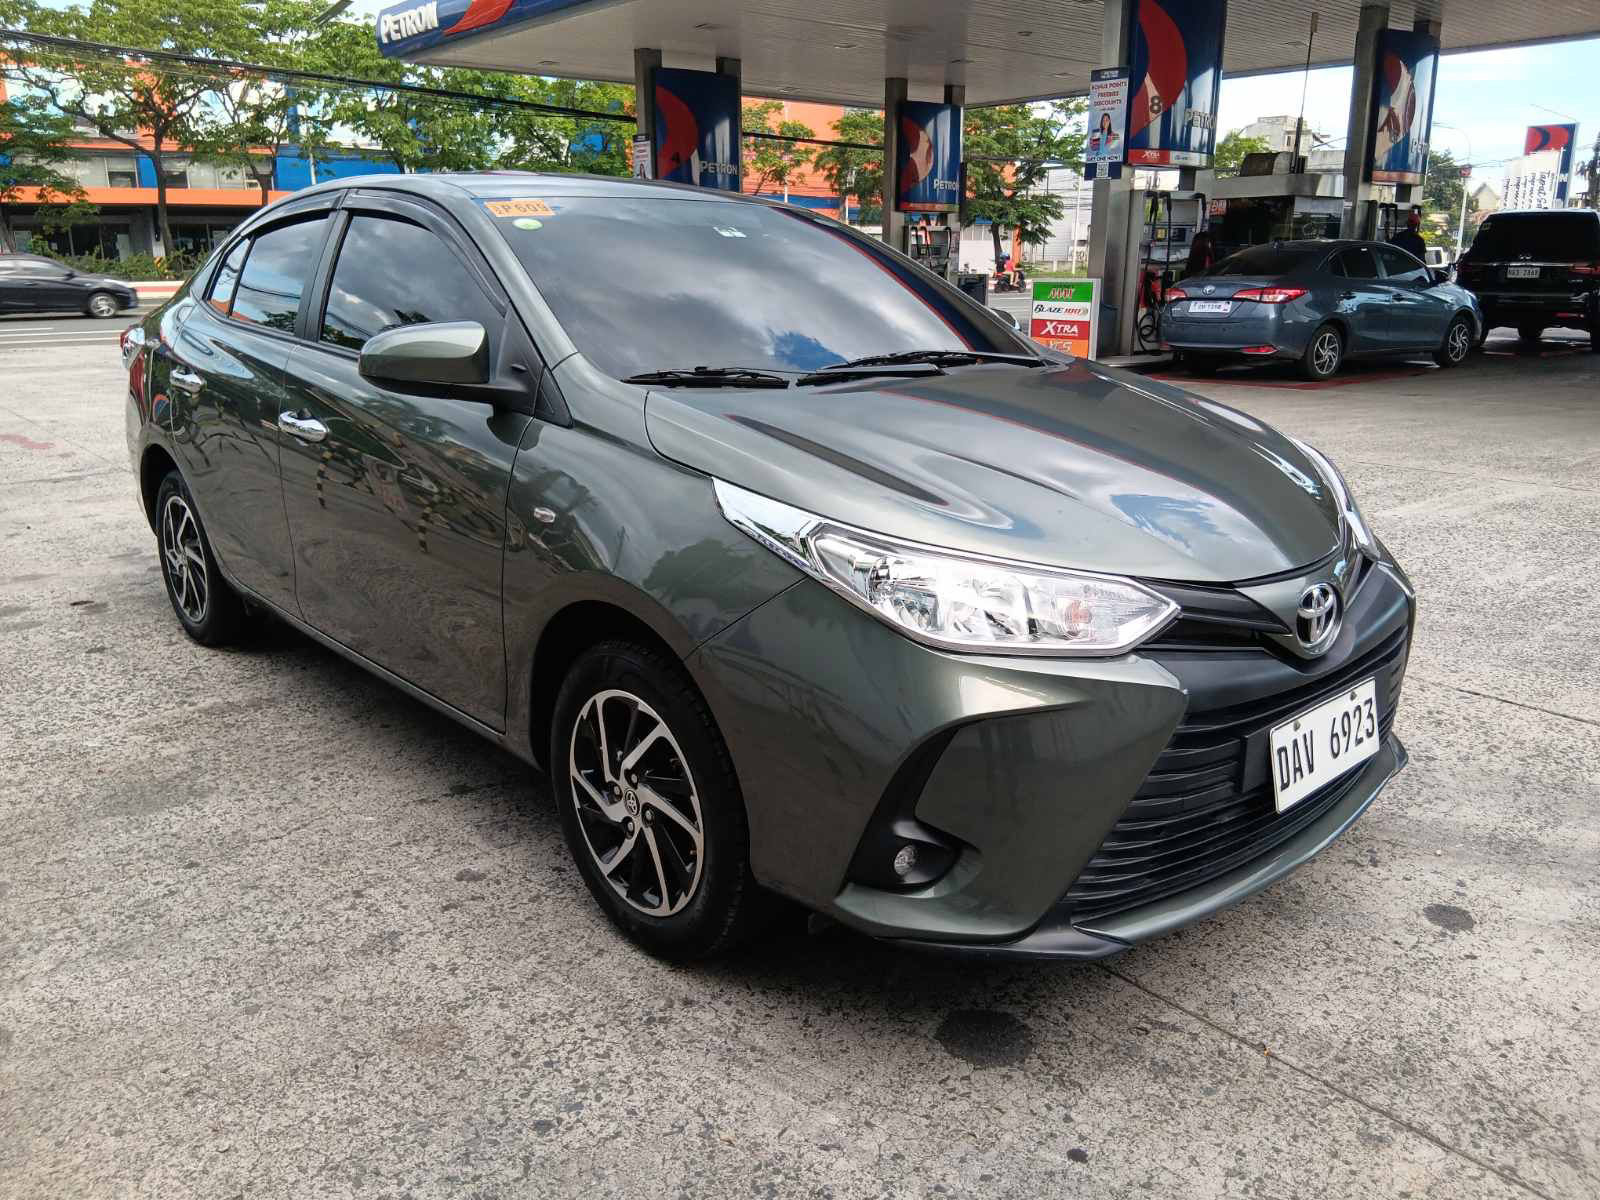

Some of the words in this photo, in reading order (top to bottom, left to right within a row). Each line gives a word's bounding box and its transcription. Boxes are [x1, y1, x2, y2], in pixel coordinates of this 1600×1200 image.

[381, 0, 438, 43] PETRON
[1150, 96, 1161, 113] 8
[701, 161, 737, 175] PETRON
[1034, 304, 1063, 314] BLAZE
[1040, 320, 1078, 336] XTRA
[1277, 729, 1314, 792] DAV
[1330, 698, 1375, 760] 6923
